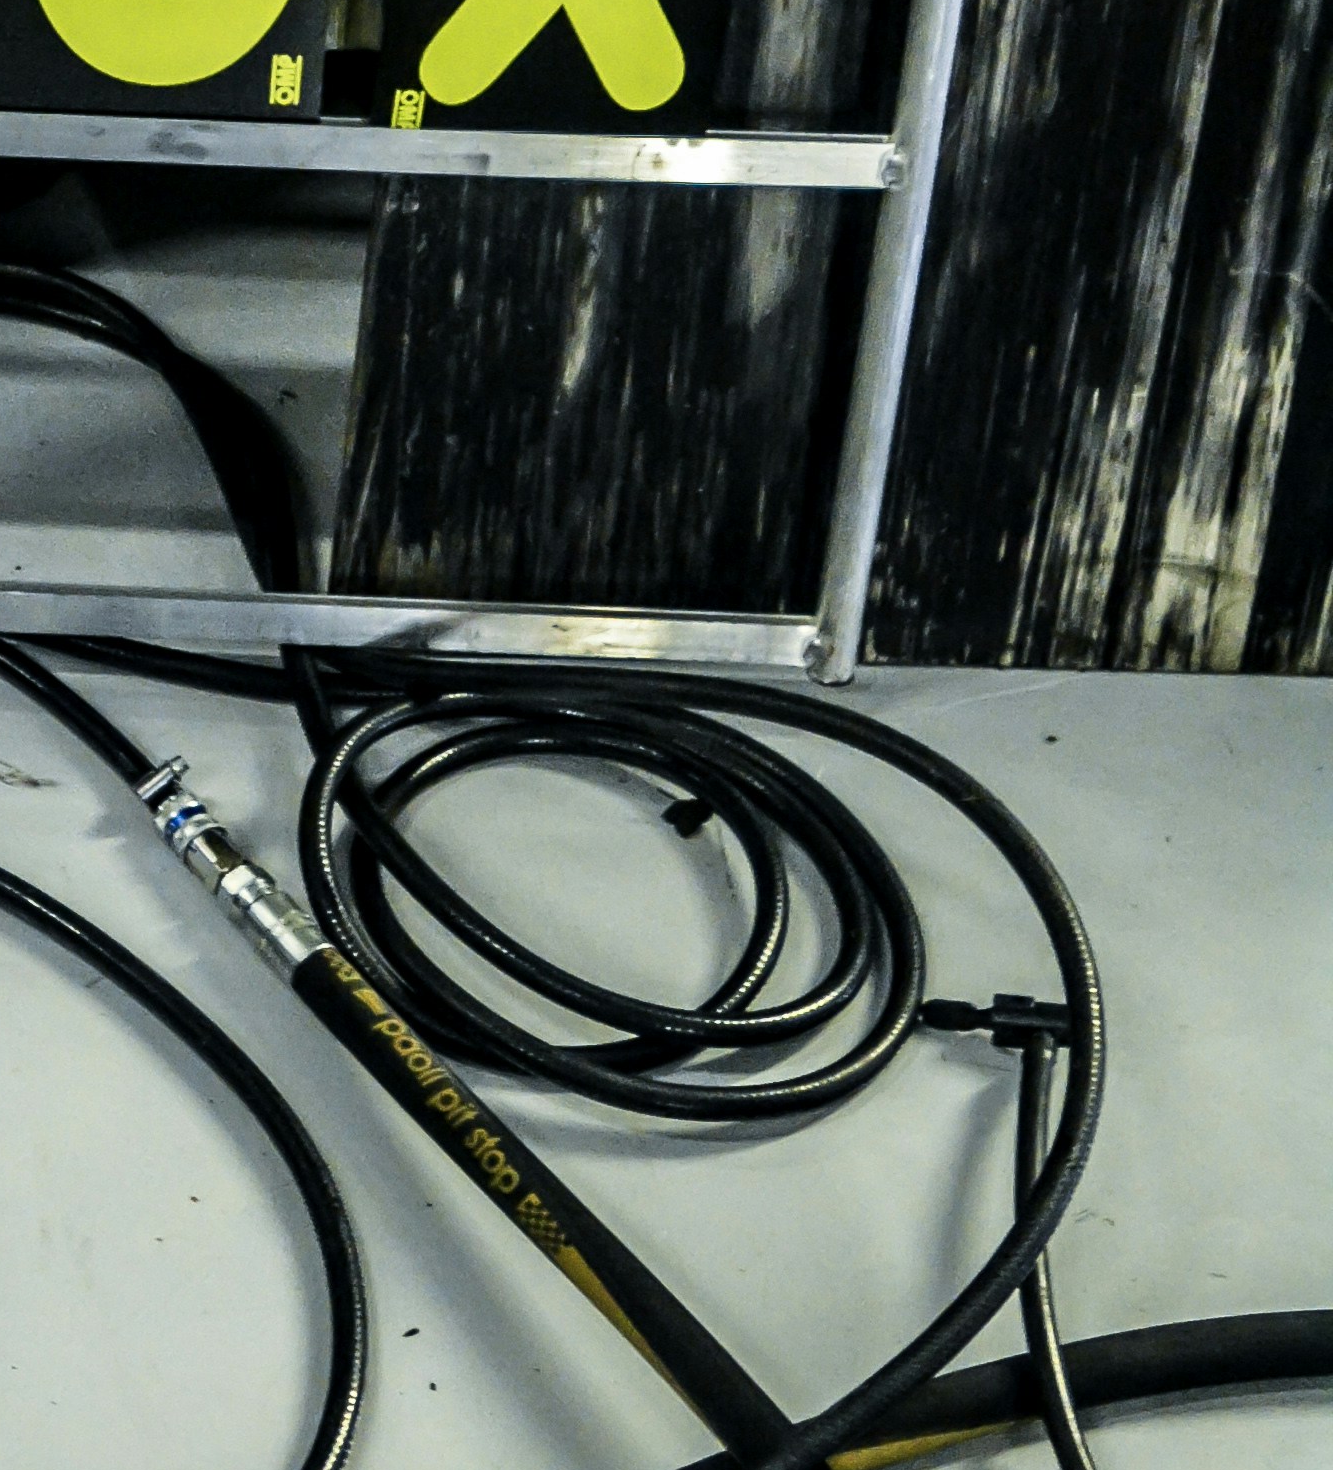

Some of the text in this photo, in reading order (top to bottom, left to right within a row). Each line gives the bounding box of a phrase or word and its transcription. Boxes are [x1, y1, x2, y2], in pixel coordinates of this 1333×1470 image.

[272, 54, 299, 106] OMP
[425, 1086, 478, 1129] pit
[462, 1126, 521, 1196] stop
